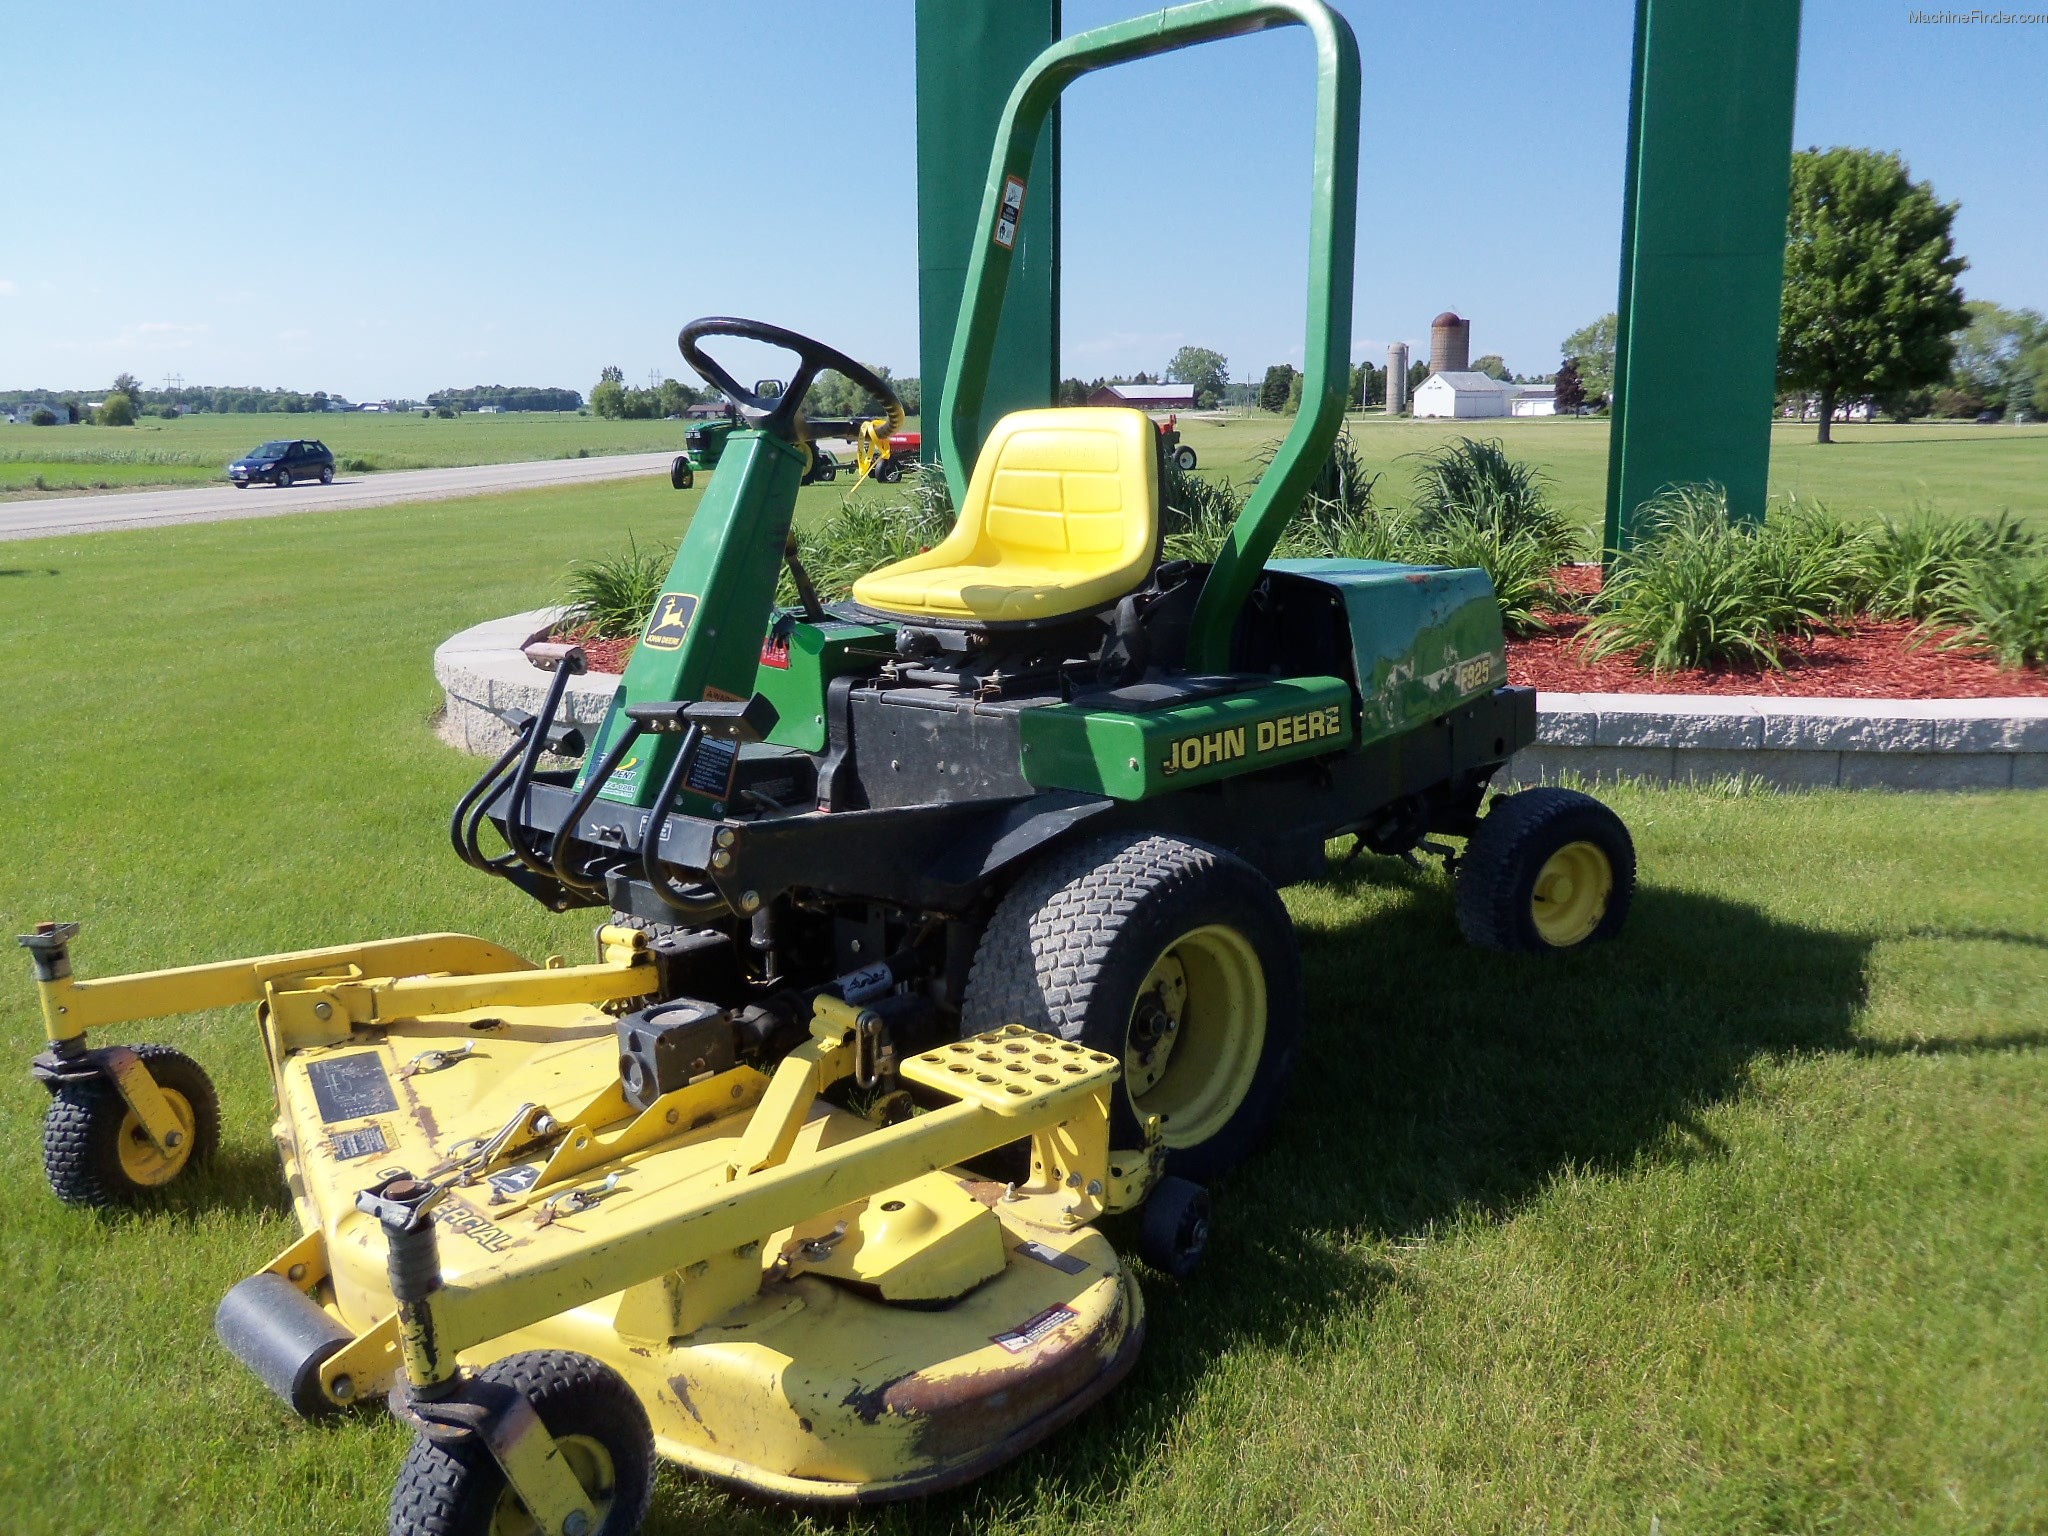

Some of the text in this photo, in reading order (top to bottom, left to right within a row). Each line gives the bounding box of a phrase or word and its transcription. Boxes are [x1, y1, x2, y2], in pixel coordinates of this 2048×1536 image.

[1460, 659, 1490, 691] F925
[1163, 706, 1340, 774] JOHN DEERE
